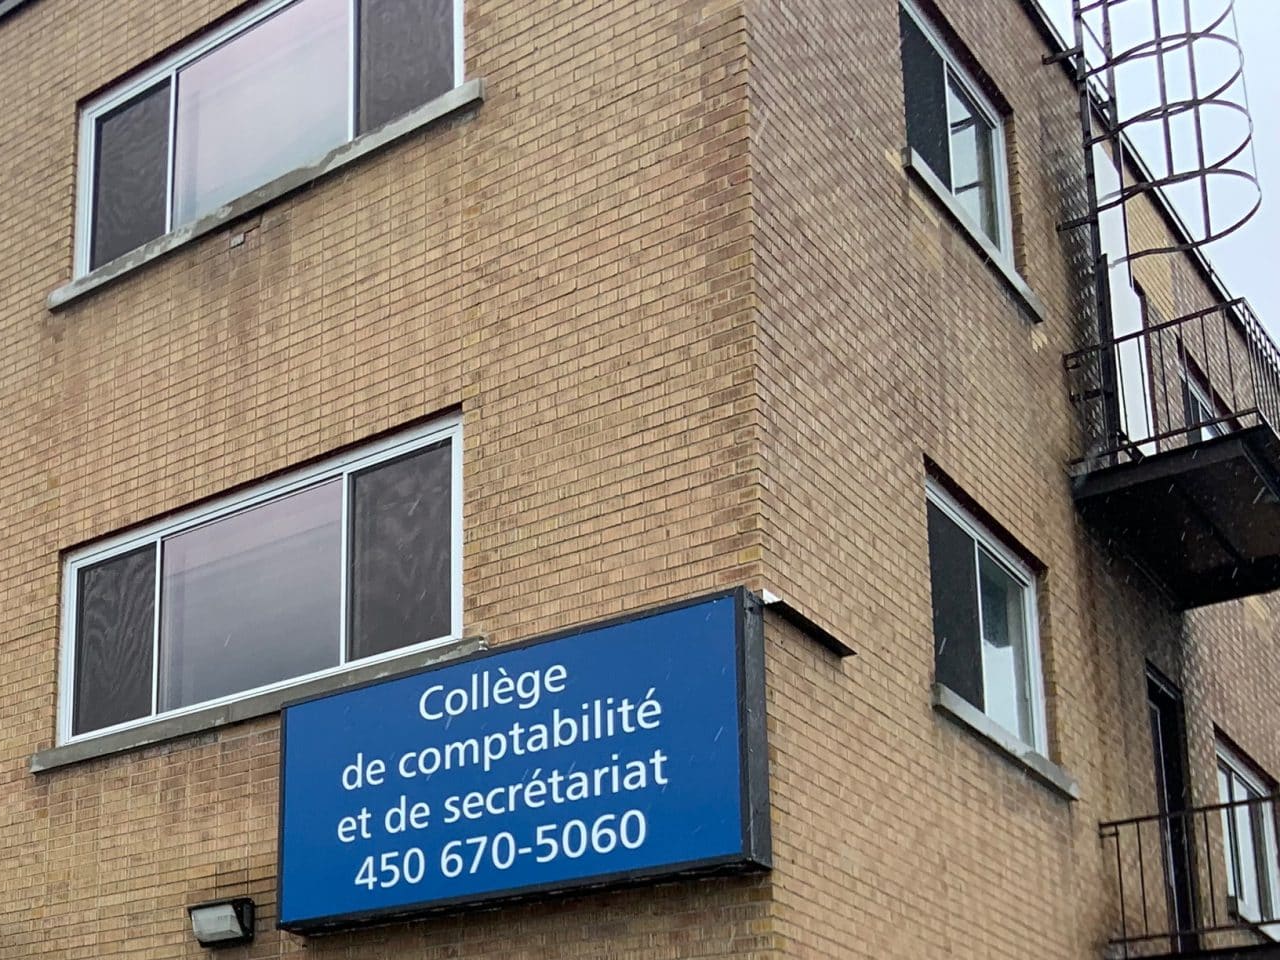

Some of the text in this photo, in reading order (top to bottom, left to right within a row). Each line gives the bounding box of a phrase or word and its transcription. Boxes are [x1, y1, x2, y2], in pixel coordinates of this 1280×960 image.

[418, 663, 568, 721] Collège
[341, 687, 663, 791] de comptabilité
[336, 749, 669, 843] et de secrétariat
[353, 808, 648, 891] 450 670-5060
